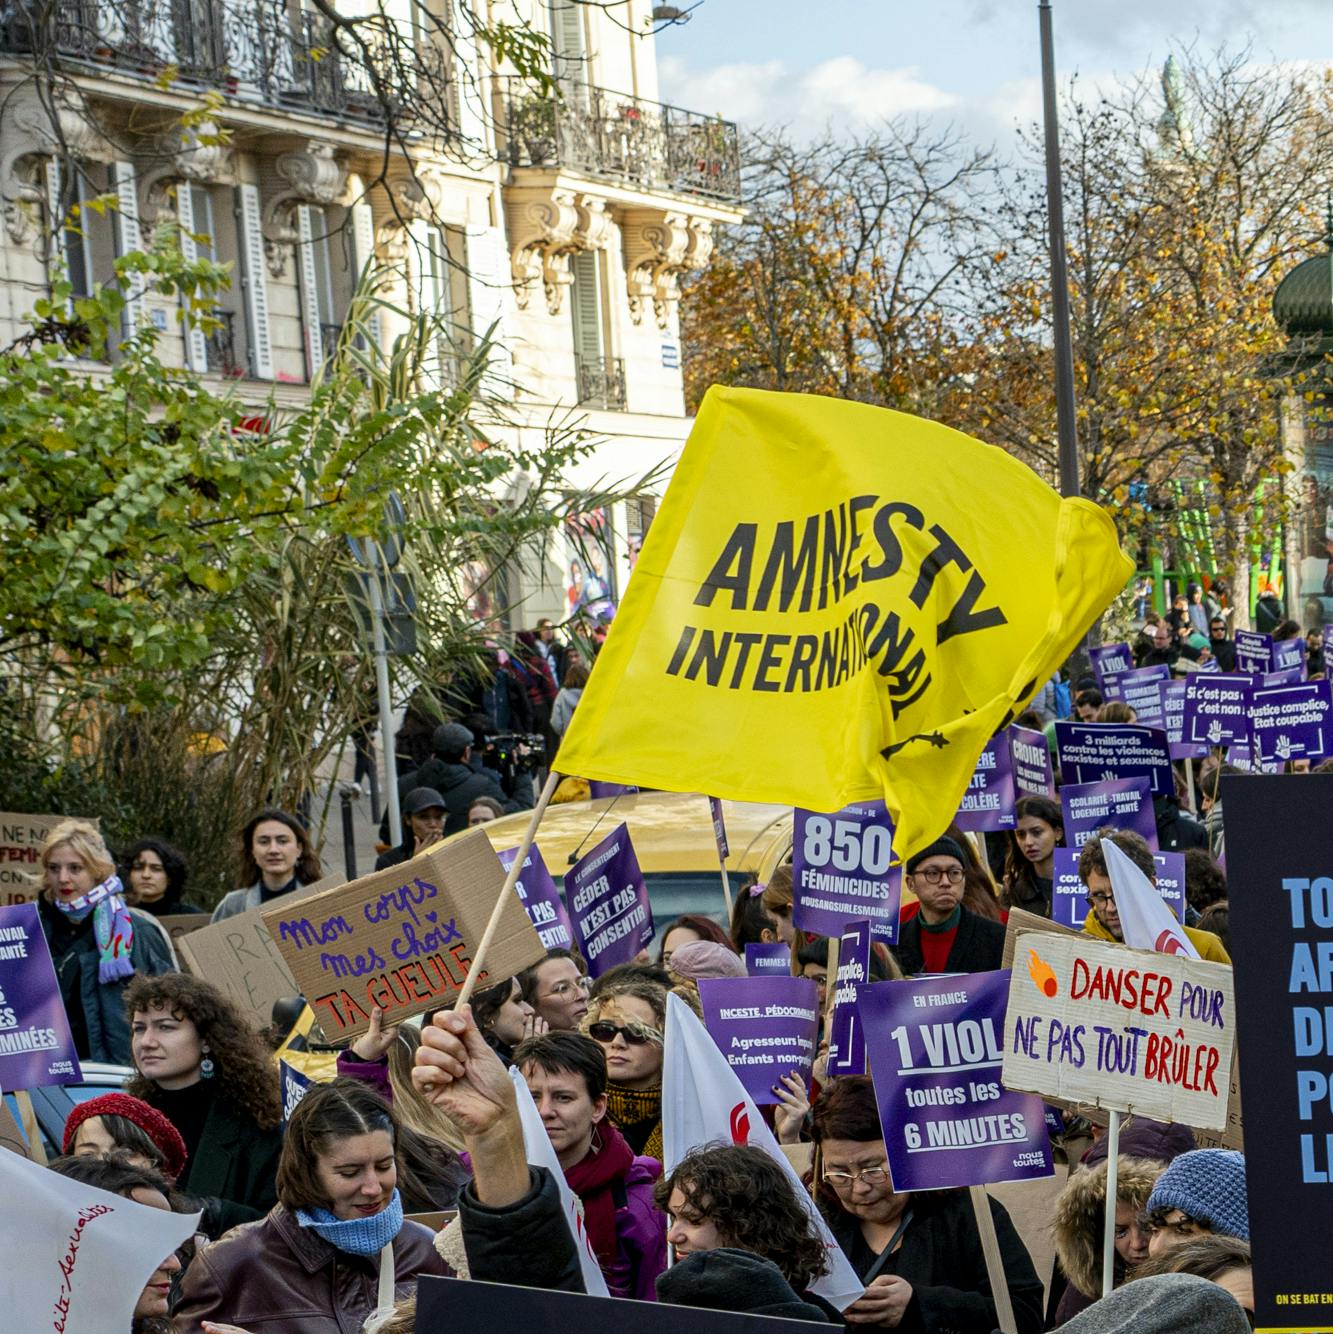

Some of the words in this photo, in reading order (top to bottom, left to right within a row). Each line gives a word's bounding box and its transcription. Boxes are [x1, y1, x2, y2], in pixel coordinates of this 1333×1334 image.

[694, 494, 1008, 645] AMNESTY
[1197, 687, 1219, 700] c'est
[1197, 701, 1220, 714] c'est
[1275, 712, 1323, 727] coupable
[1013, 739, 1047, 767] CROIRE
[1063, 745, 1097, 756] contre
[1114, 746, 1166, 757] violences
[1094, 735, 1141, 746] milliards
[1062, 754, 1103, 765] sexistes
[1119, 756, 1169, 767] sexuelles
[1071, 804, 1110, 820] LOGEMENT
[1117, 802, 1139, 815] SANTÉ
[803, 816, 891, 875] 850
[573, 875, 611, 913] CÉDER
[801, 868, 889, 900] FÉMINICIDES
[279, 913, 353, 950] Mon
[364, 877, 438, 926] corps
[391, 917, 463, 960] choix
[587, 905, 646, 960] CONSENTIR
[913, 995, 927, 1008] EN
[928, 991, 968, 1006] FRANCE
[1070, 958, 1173, 1020] DANSER
[1179, 981, 1225, 1029] POUR
[315, 989, 370, 1030] TA
[731, 1036, 797, 1051] Agresseurs
[919, 1018, 1003, 1067] VIOL
[1013, 1015, 1042, 1060] NE
[1047, 1018, 1086, 1068] PAS
[1093, 1026, 1149, 1076] TOUT
[1144, 1028, 1220, 1097] BRÛLER
[728, 1053, 774, 1066] Enfants
[906, 1086, 967, 1108] toutes
[926, 1113, 1027, 1147] MINUTES
[1276, 1294, 1289, 1305] ON
[1290, 1294, 1302, 1305] SE
[1303, 1293, 1319, 1304] BAT
